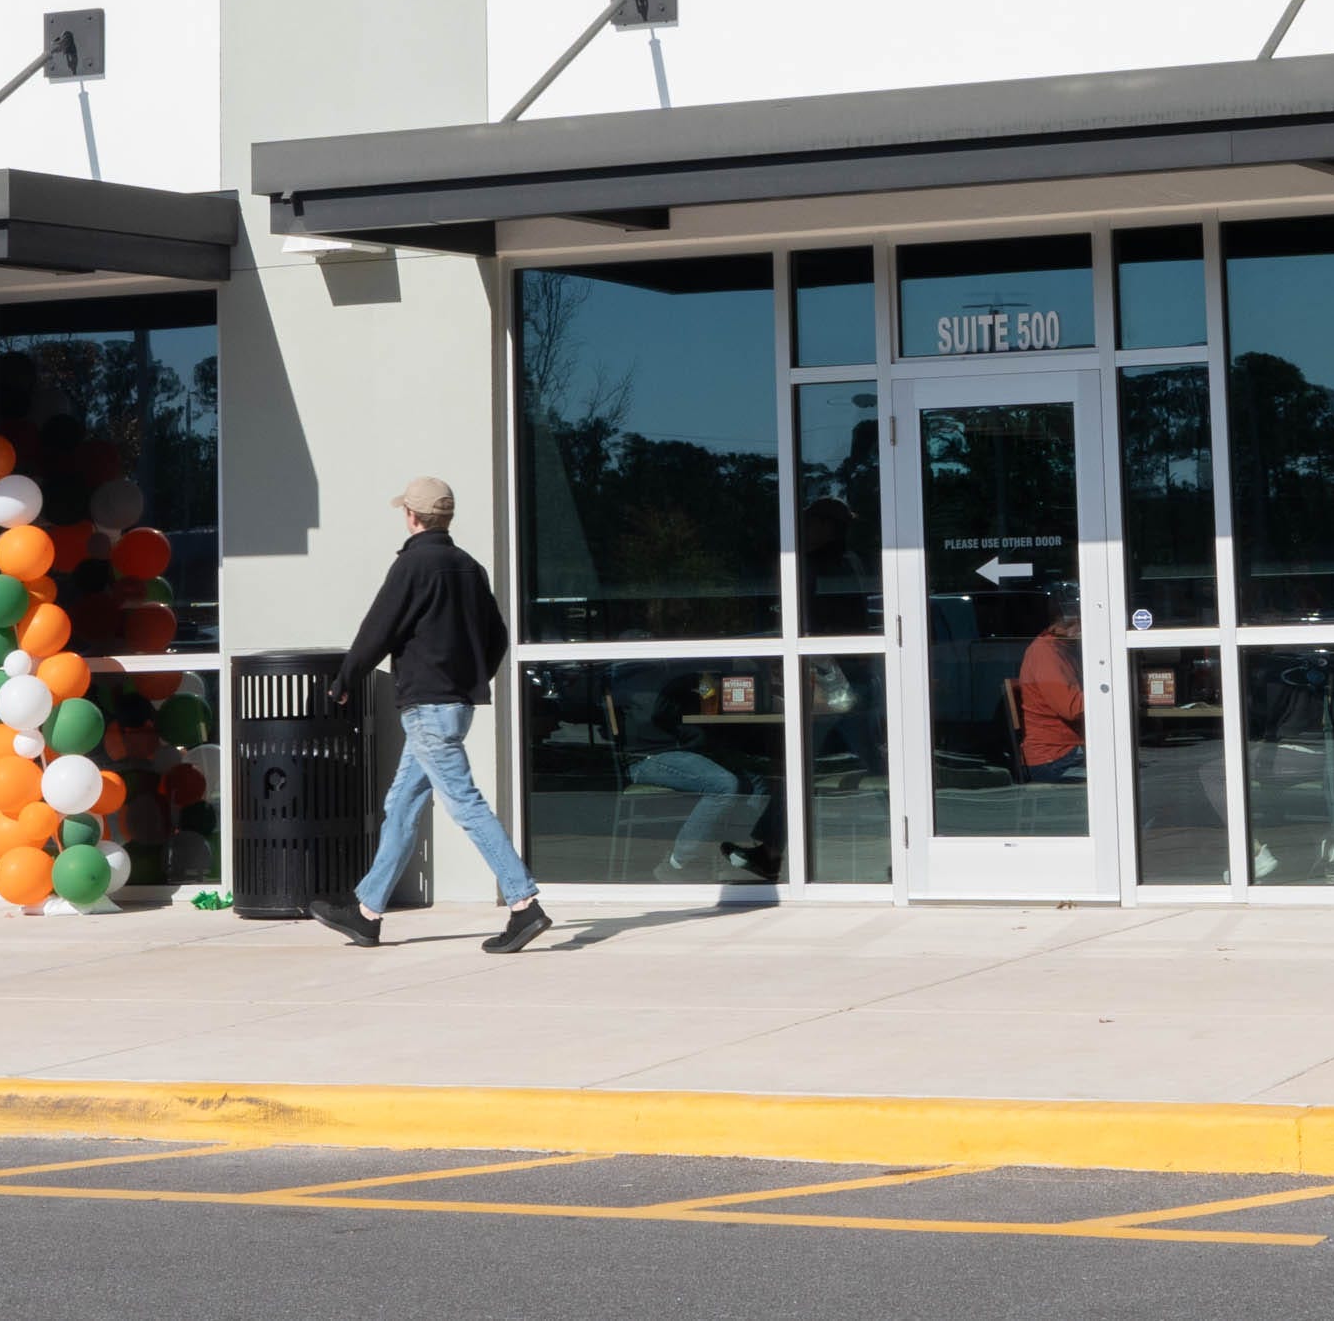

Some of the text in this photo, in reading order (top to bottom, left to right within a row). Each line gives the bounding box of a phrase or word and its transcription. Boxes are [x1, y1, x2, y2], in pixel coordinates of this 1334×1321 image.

[938, 310, 1059, 353] SUITE 500
[944, 536, 1062, 549] PLEASE USE OTHER DOOR
